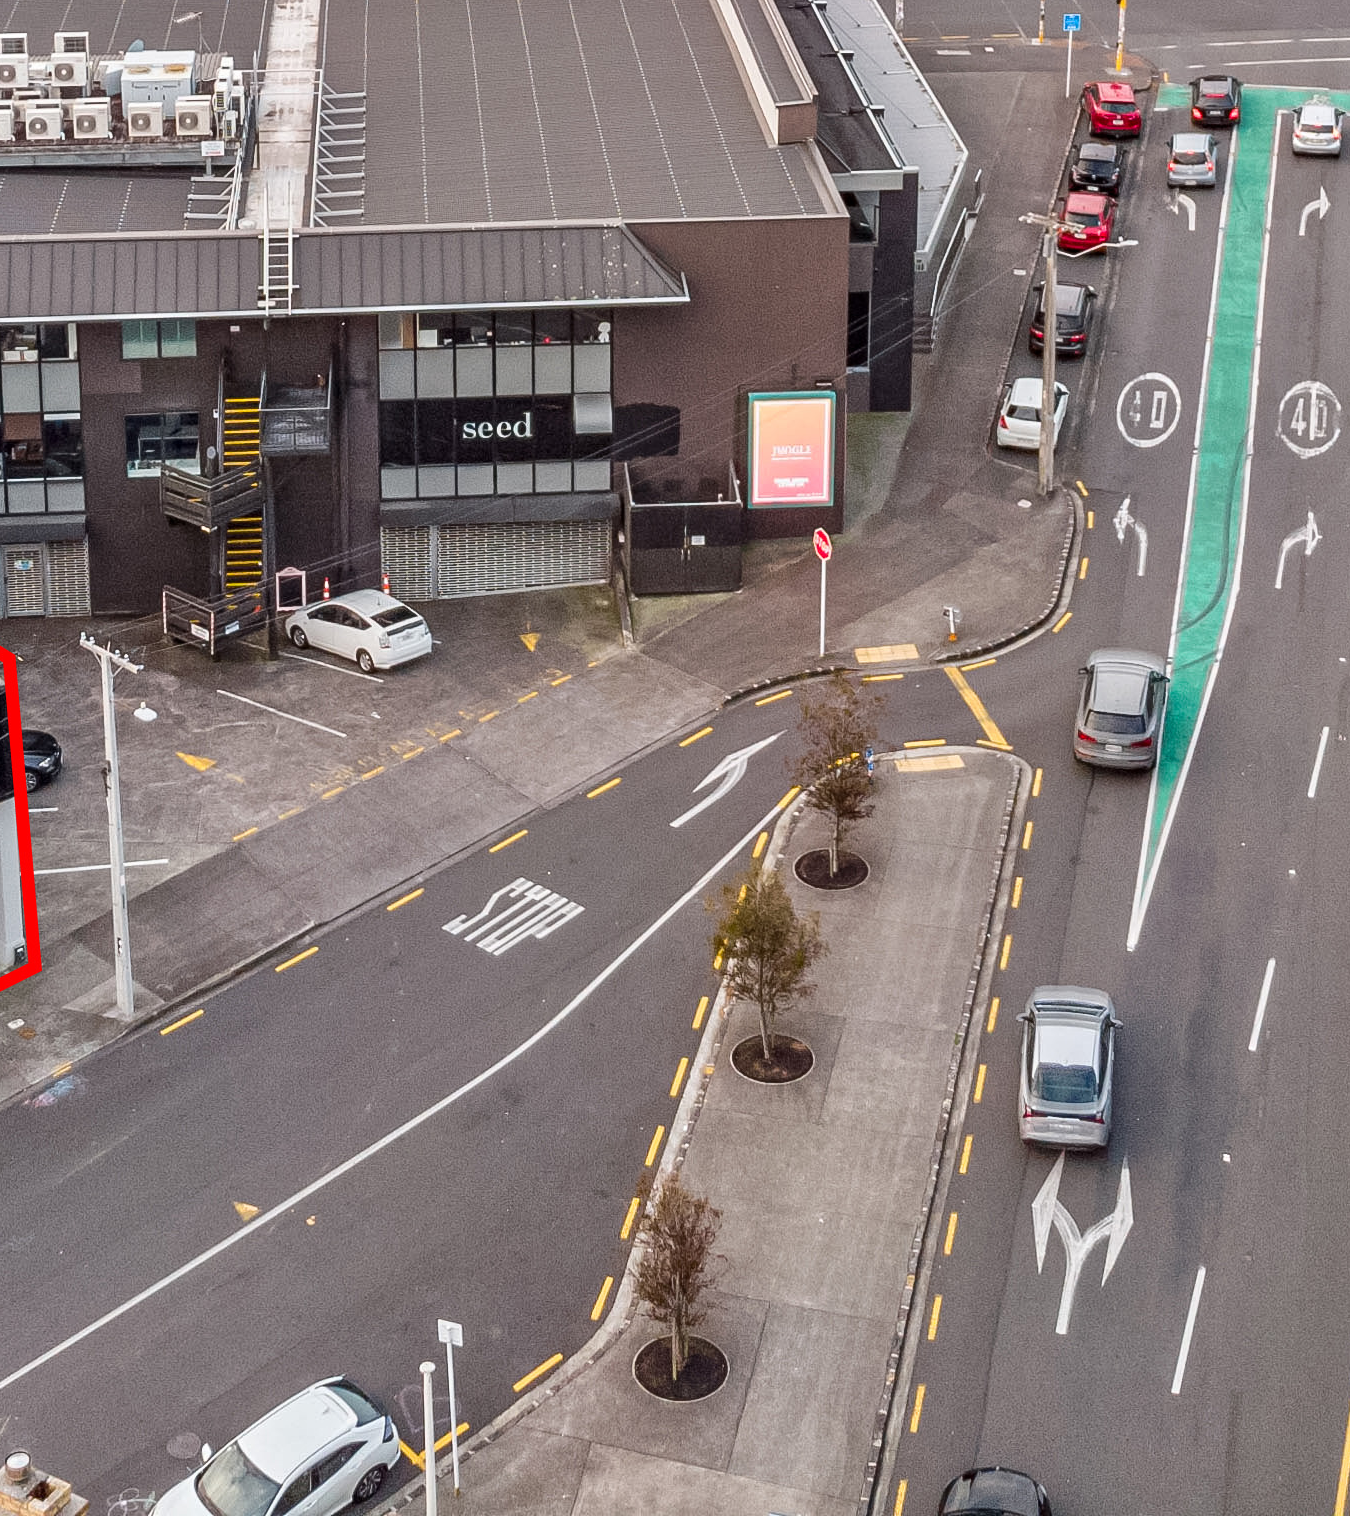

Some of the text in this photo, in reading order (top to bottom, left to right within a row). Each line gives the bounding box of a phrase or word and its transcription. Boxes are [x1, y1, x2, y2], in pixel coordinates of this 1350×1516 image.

[461, 411, 533, 440] seed
[814, 533, 832, 554] STOP
[441, 876, 586, 956] STOP
